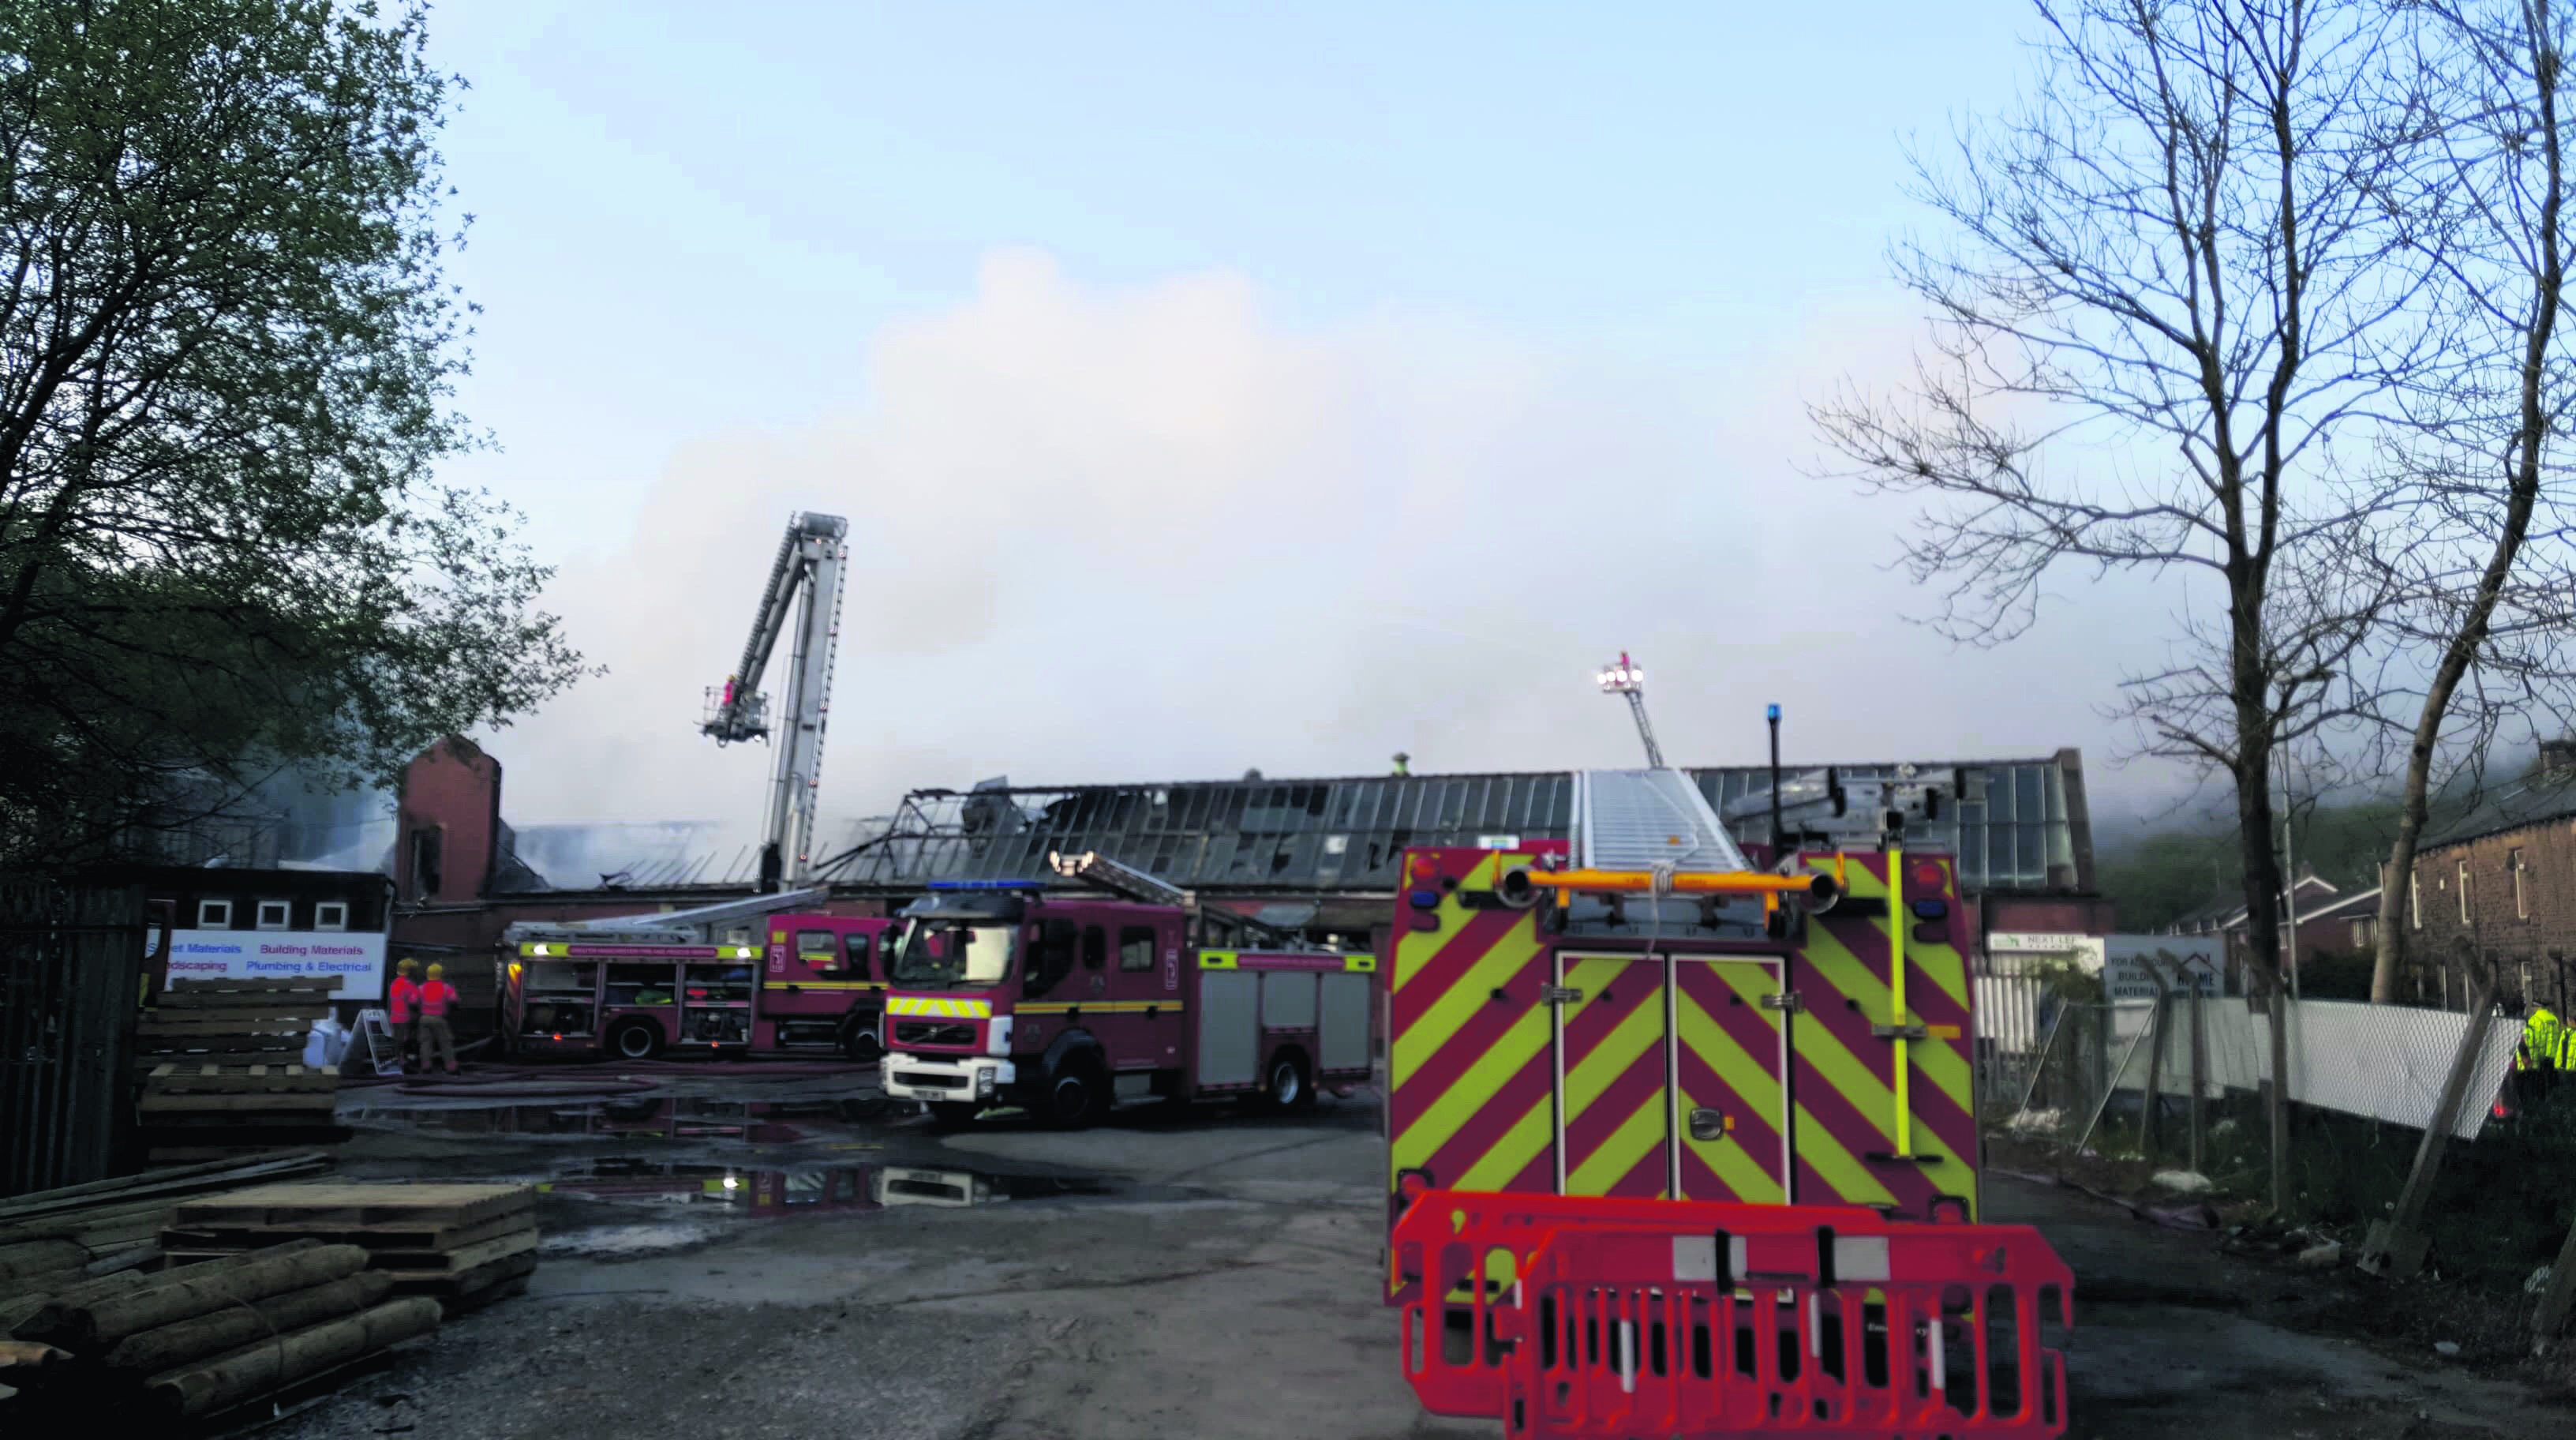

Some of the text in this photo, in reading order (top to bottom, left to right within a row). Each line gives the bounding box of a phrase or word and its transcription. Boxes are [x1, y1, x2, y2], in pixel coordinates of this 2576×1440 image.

[188, 943, 242, 953] Materials
[260, 944, 363, 956] Building Materials
[246, 961, 301, 972] Plumbing
[318, 962, 371, 971] Electrical
[2118, 972, 2152, 981] BUILDI
